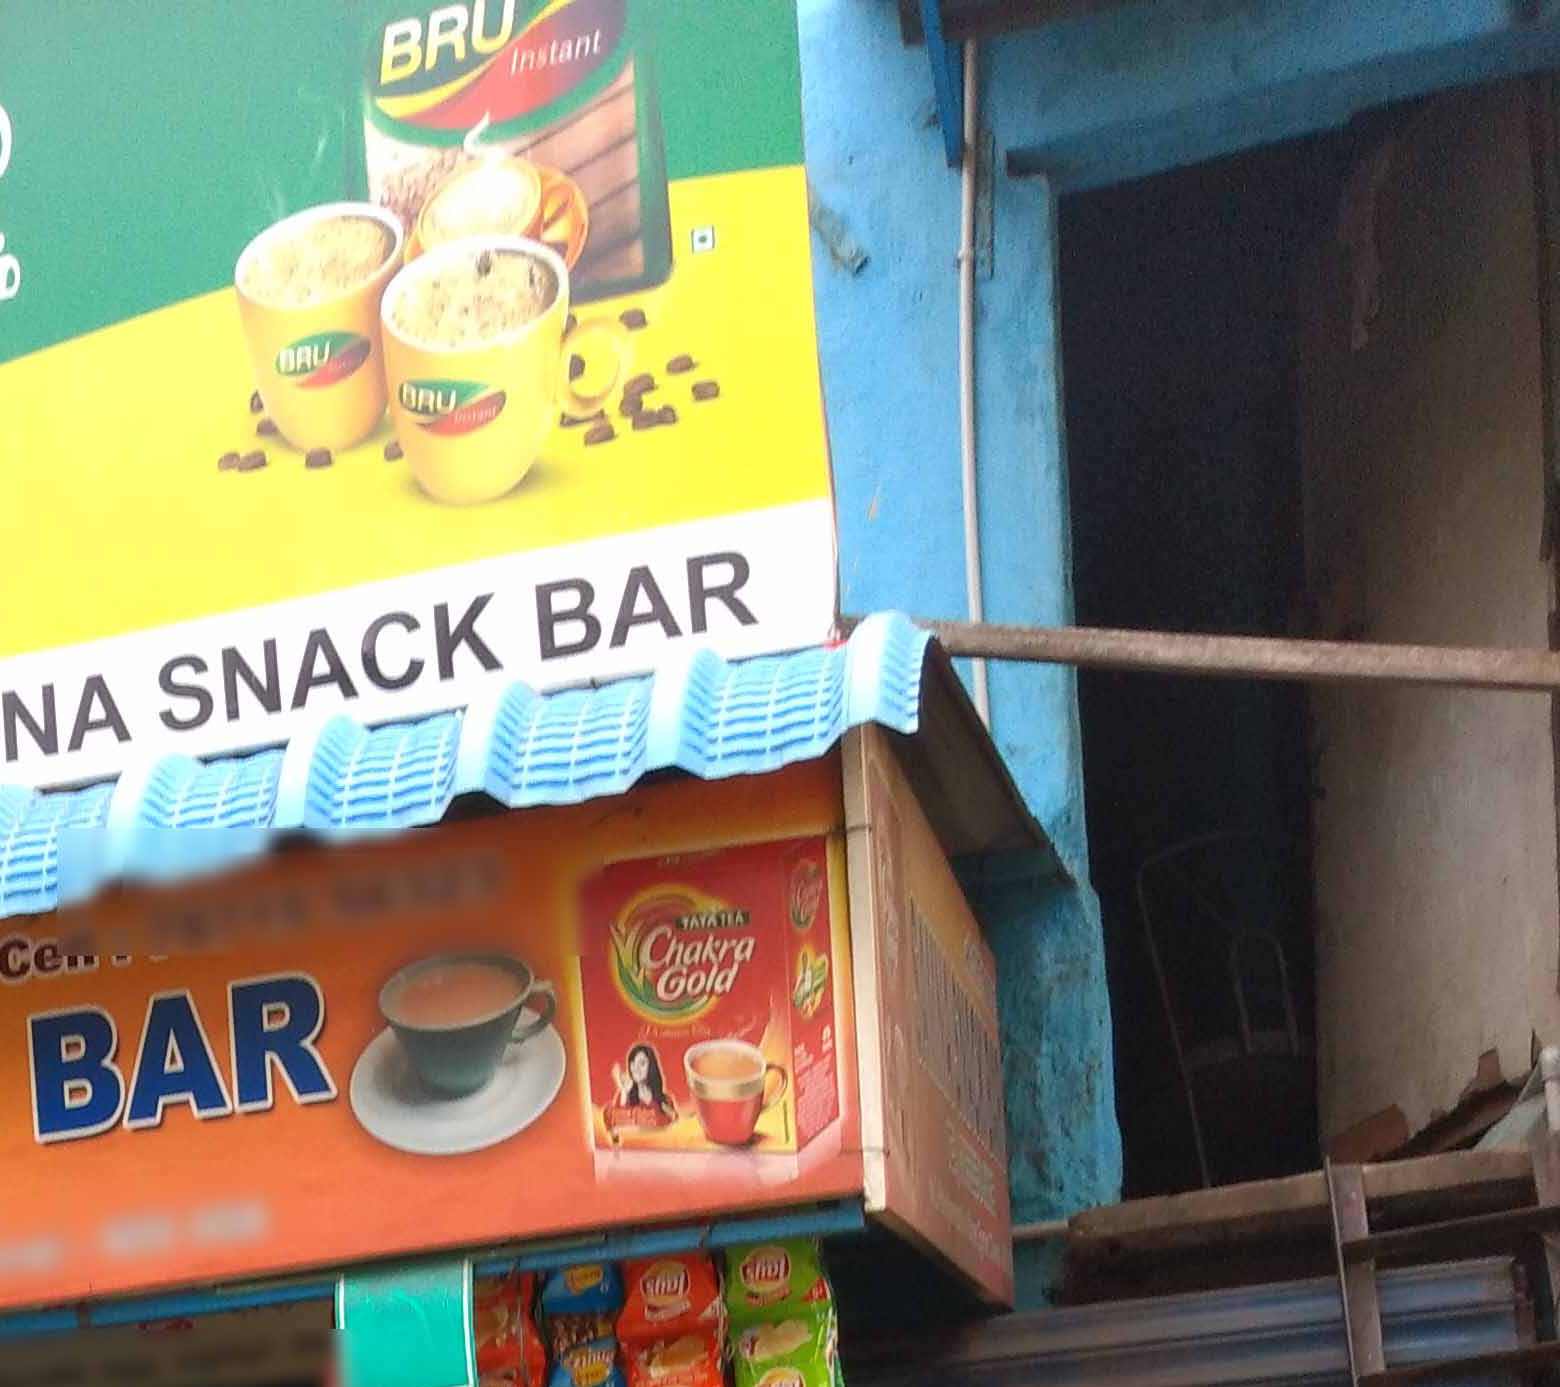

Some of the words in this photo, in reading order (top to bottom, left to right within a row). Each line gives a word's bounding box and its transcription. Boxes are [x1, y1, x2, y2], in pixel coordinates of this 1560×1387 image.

[378, 0, 517, 85] BRU
[510, 30, 602, 77] Instant
[401, 382, 458, 414] BRU
[157, 592, 504, 732] SNACK
[533, 549, 760, 662] BAR
[641, 925, 756, 969] Chakra
[657, 963, 739, 1002] Gold
[26, 972, 340, 1145] BAR
